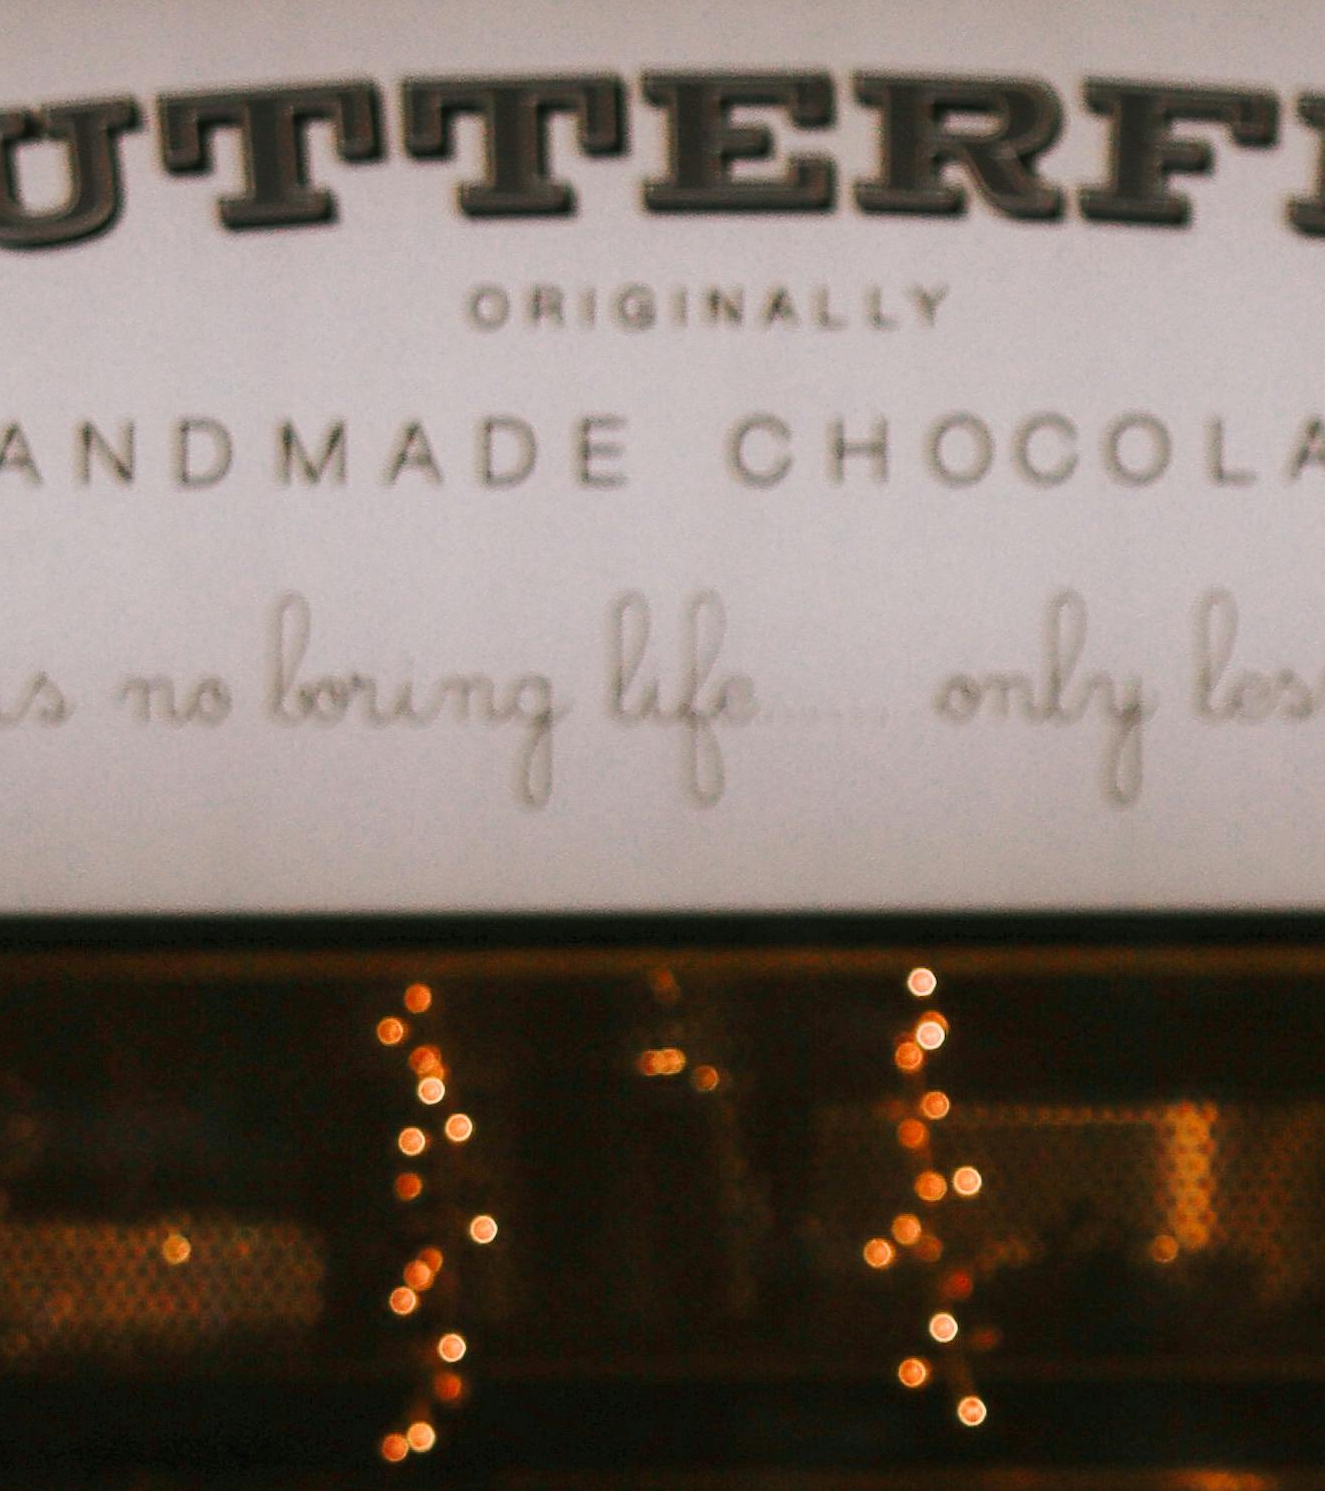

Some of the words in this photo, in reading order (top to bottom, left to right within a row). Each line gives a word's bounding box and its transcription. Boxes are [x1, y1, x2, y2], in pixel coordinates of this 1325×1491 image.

[465, 282, 950, 334] ORIGINALLY
[119, 673, 233, 726] no
[268, 590, 568, 810] boring
[934, 586, 1154, 809] only
